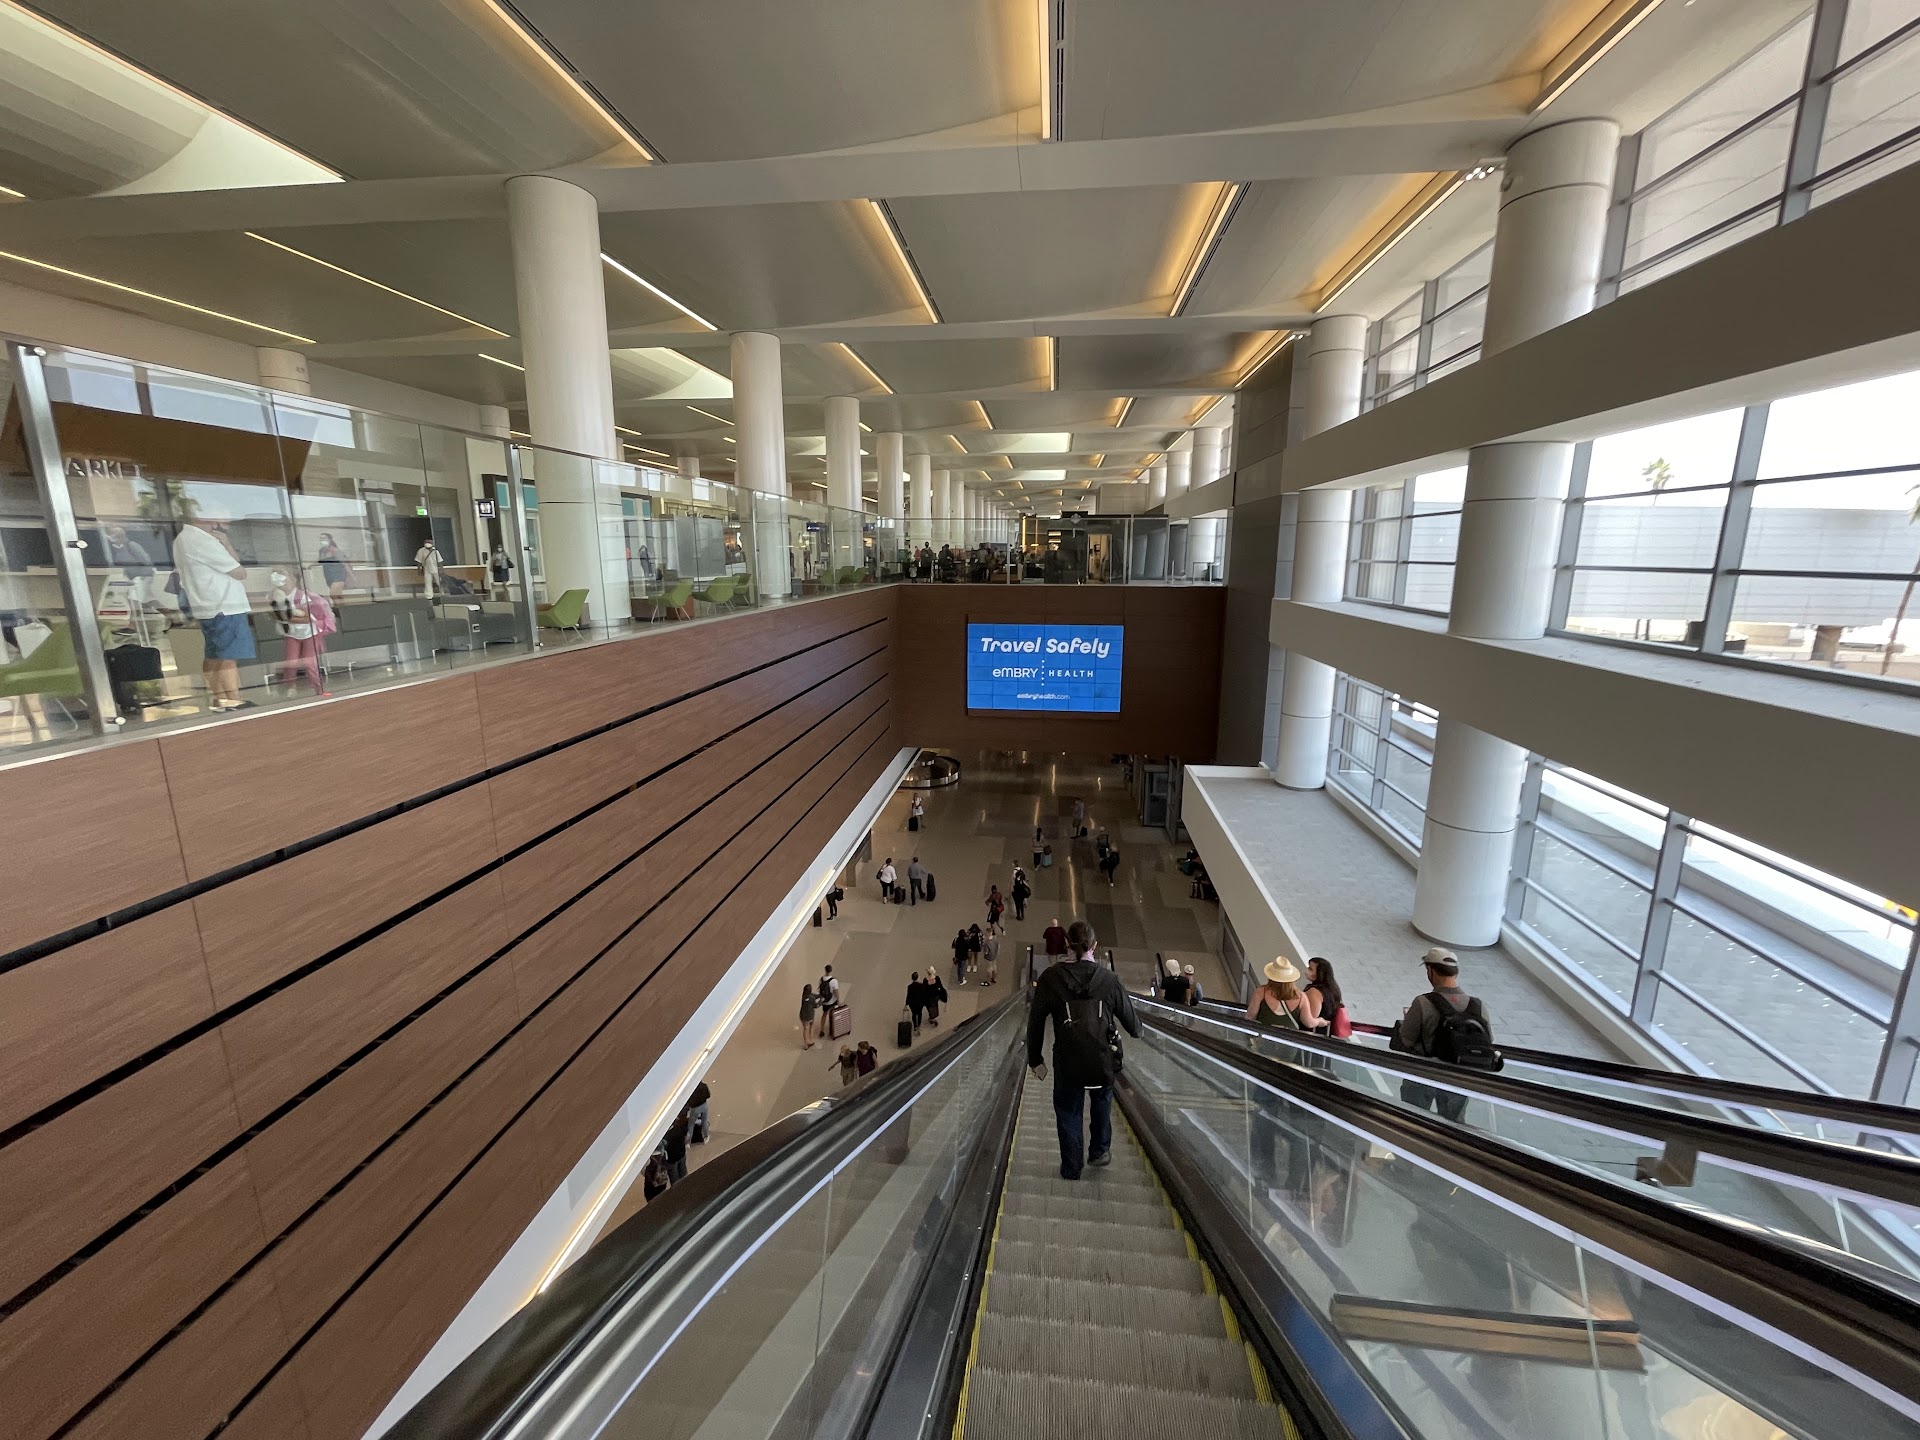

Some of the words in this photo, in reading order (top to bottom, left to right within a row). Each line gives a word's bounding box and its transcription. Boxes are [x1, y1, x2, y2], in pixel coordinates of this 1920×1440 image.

[981, 637, 1041, 652] Travel
[1046, 637, 1110, 658] Safely
[1048, 669, 1094, 677] HEALTH
